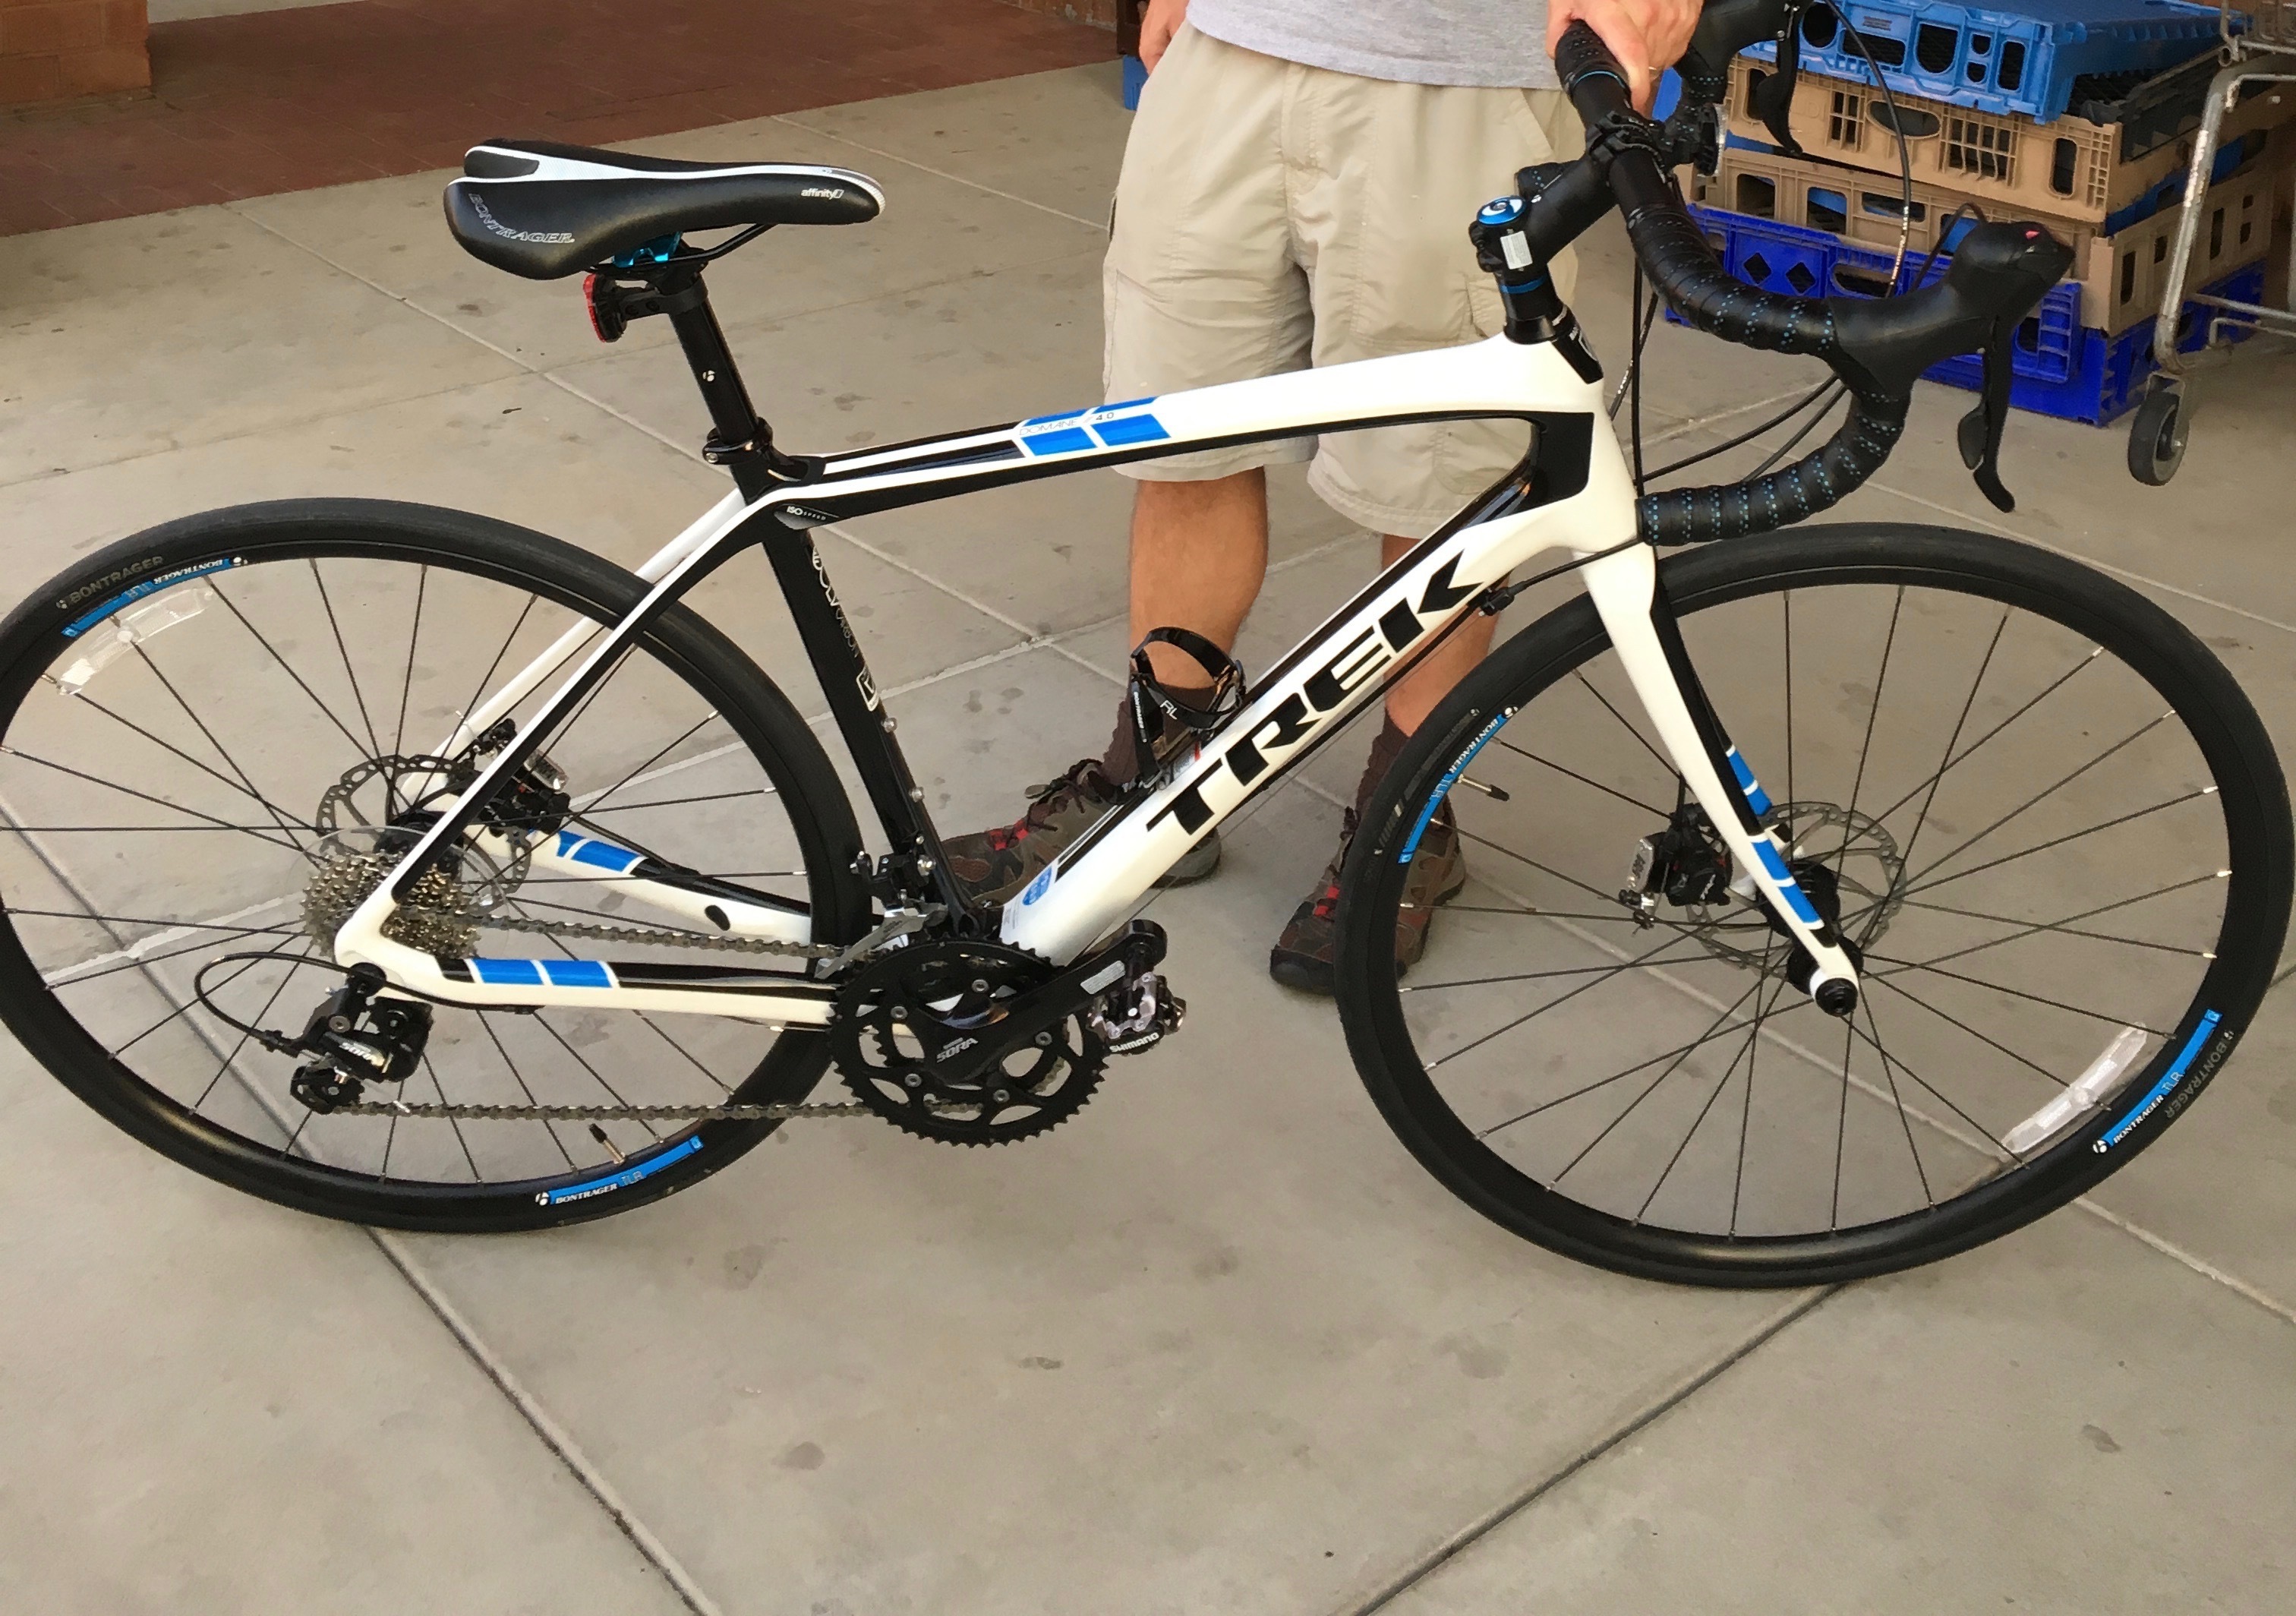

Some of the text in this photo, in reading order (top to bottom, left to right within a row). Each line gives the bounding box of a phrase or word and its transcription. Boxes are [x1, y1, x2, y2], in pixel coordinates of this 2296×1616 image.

[800, 188, 835, 200] affinity
[468, 193, 576, 243] BONTRAGER
[1019, 418, 1078, 436] DOMANE
[70, 555, 164, 604] BONTRAGER
[154, 559, 224, 585] BONTRAGER
[1146, 548, 1484, 836] TREK
[1448, 718, 1499, 774] BONTRAGER
[937, 1037, 979, 1063] SORA
[1109, 1032, 1159, 1053] SHIMANO
[2165, 1040, 2228, 1119] BONTRAGER
[2113, 1094, 2165, 1144] BONTRAGER
[555, 1183, 618, 1205] BONTRAGER
